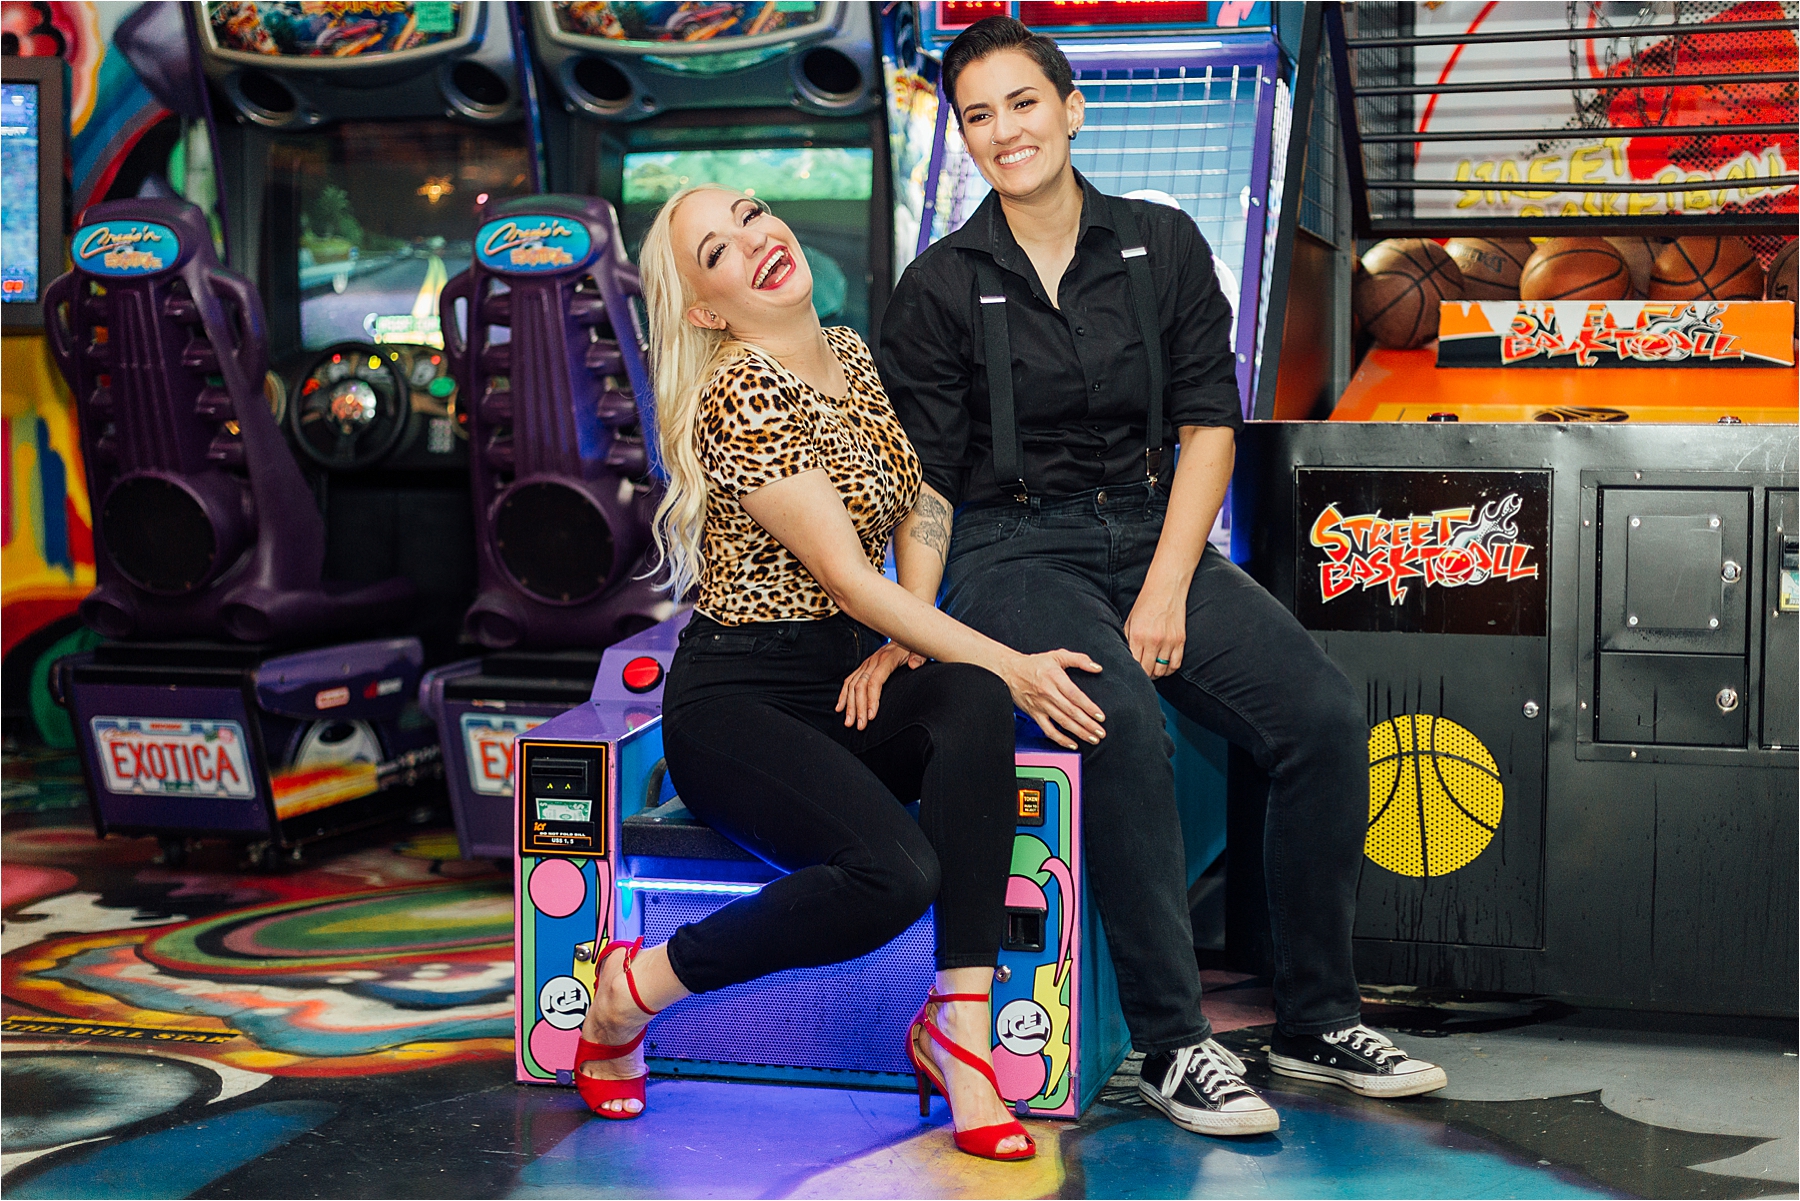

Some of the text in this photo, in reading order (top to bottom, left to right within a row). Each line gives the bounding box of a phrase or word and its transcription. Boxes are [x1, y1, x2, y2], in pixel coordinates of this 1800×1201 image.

[1310, 502, 1476, 564] STREET
[110, 742, 239, 782] EXOTICA
[543, 986, 588, 1017] ICE
[1001, 1010, 1050, 1042] ICE
